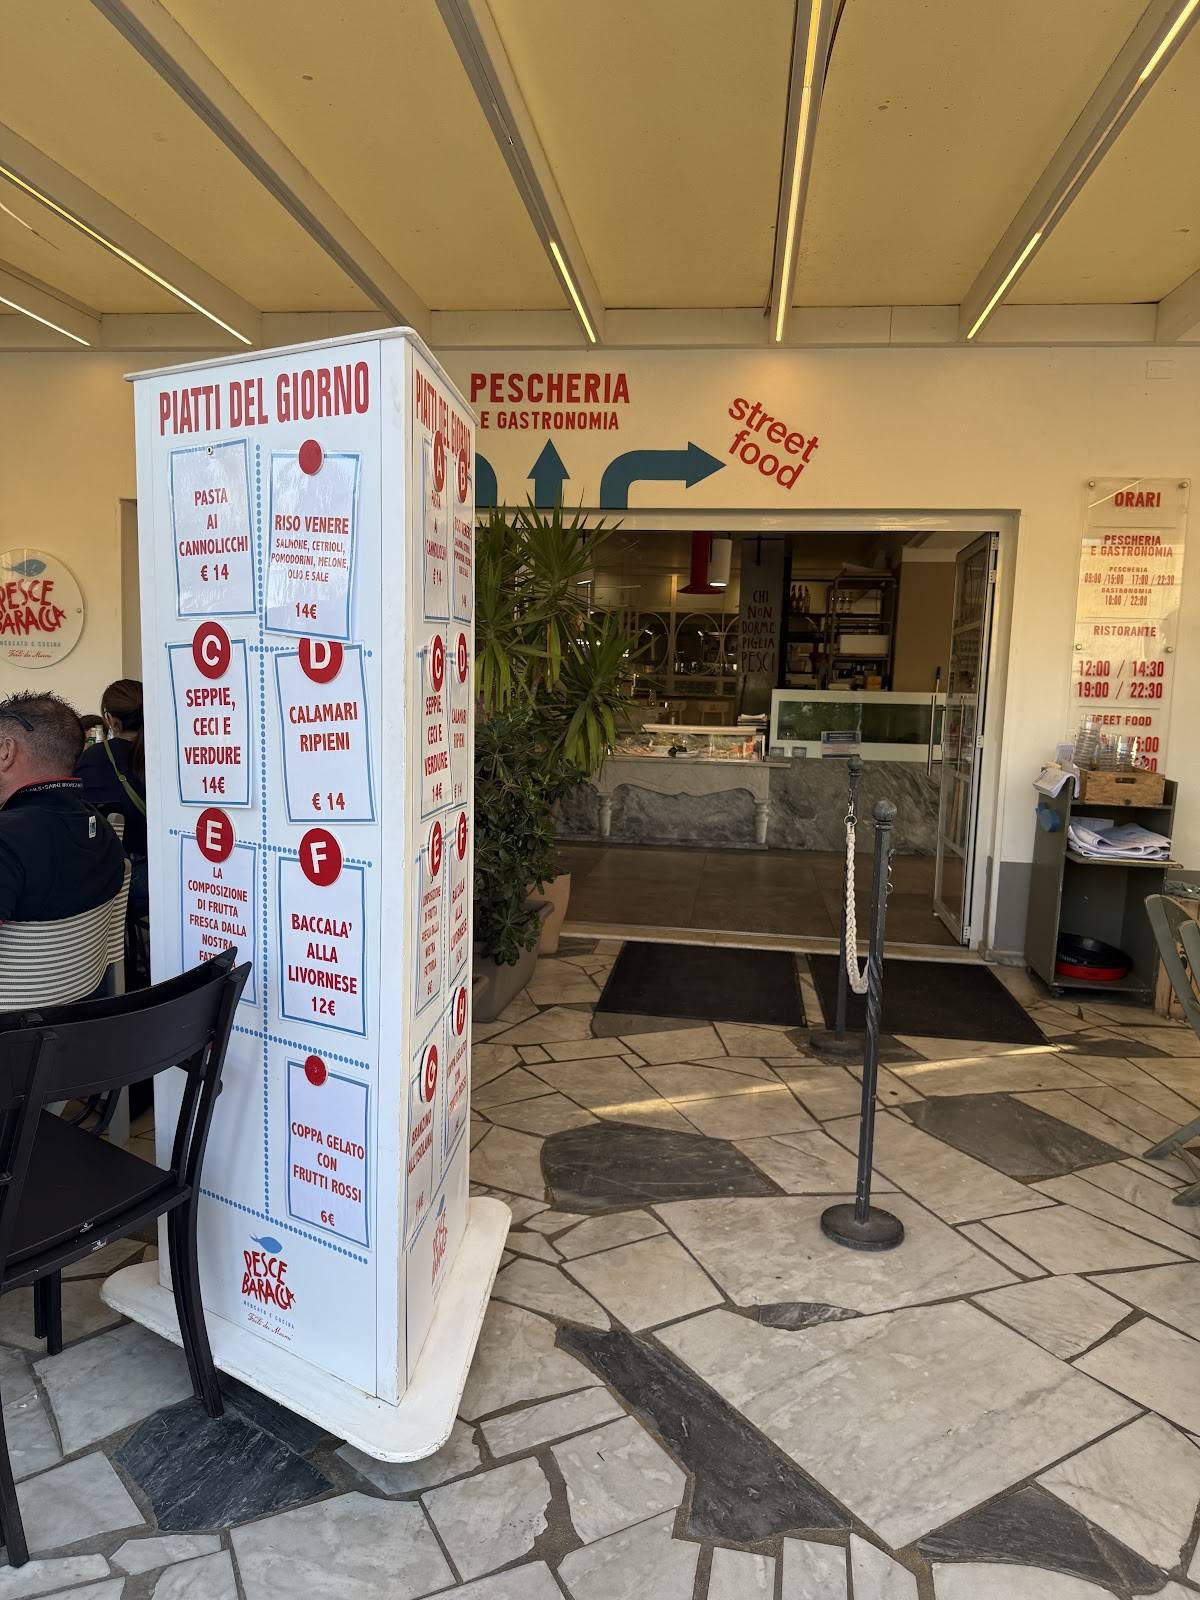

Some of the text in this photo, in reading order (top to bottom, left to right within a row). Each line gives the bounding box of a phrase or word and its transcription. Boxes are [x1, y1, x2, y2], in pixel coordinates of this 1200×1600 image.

[160, 361, 369, 436] PIATTI DEL GIORNO
[470, 373, 630, 404] PESCHERIA
[480, 411, 619, 430] E GASTRONOMIA
[727, 396, 819, 464] street
[728, 430, 804, 490] food
[194, 487, 228, 506] PASTA
[1114, 491, 1161, 508] ORARI
[207, 514, 218, 530] AI
[275, 514, 349, 535] RISO VENERE
[179, 535, 249, 557] CANNOLICCHI
[276, 538, 346, 556] SALMONE, CETRIOLI,
[1104, 534, 1161, 546] PESCHERIA
[1090, 545, 1173, 557] E GASTRONOMIA
[271, 552, 349, 571] POMODORINI, MELONE,
[200, 563, 230, 582] € 14
[305, 571, 310, 581] E
[312, 571, 329, 582] SALE
[753, 589, 769, 604] CHI
[1130, 595, 1148, 606] 22:00
[0, 605, 67, 636] ARACCA
[295, 602, 317, 619] 14€
[742, 620, 776, 636] DORME
[1093, 625, 1157, 637] RISTORANTE
[201, 634, 222, 667] C
[742, 637, 775, 650] PIGLIA
[310, 639, 332, 670] D
[741, 651, 776, 674] PESCI
[1078, 659, 1164, 679] 12:00 / 14:30
[185, 686, 236, 711] SEPPIE,
[1077, 681, 1163, 700] 19:00 / 22:30
[289, 702, 358, 724] CALAMARI
[1125, 715, 1152, 726] FOOD
[193, 716, 231, 736] CECI E
[300, 731, 350, 752] RIPIENI
[184, 746, 241, 765] VERDURE
[202, 776, 225, 794] 14€
[311, 792, 345, 811] € 14
[205, 819, 223, 852] E
[309, 841, 327, 874] F
[212, 866, 223, 880] LA
[187, 879, 248, 903] COMPOSIZIONE
[197, 898, 239, 918] DI FRUTTA
[189, 914, 248, 937] FRESCA DALLA
[202, 933, 234, 951] NOSTRA
[306, 942, 339, 964] ALLA
[288, 964, 358, 995] LIVORNESE
[312, 996, 336, 1017] 12€
[291, 1121, 365, 1160] COPPA GELATO
[317, 1151, 338, 1172] CON
[293, 1164, 362, 1203] FRUTTI ROSSI
[320, 1210, 335, 1227] 6€
[243, 1250, 288, 1286] PESCE
